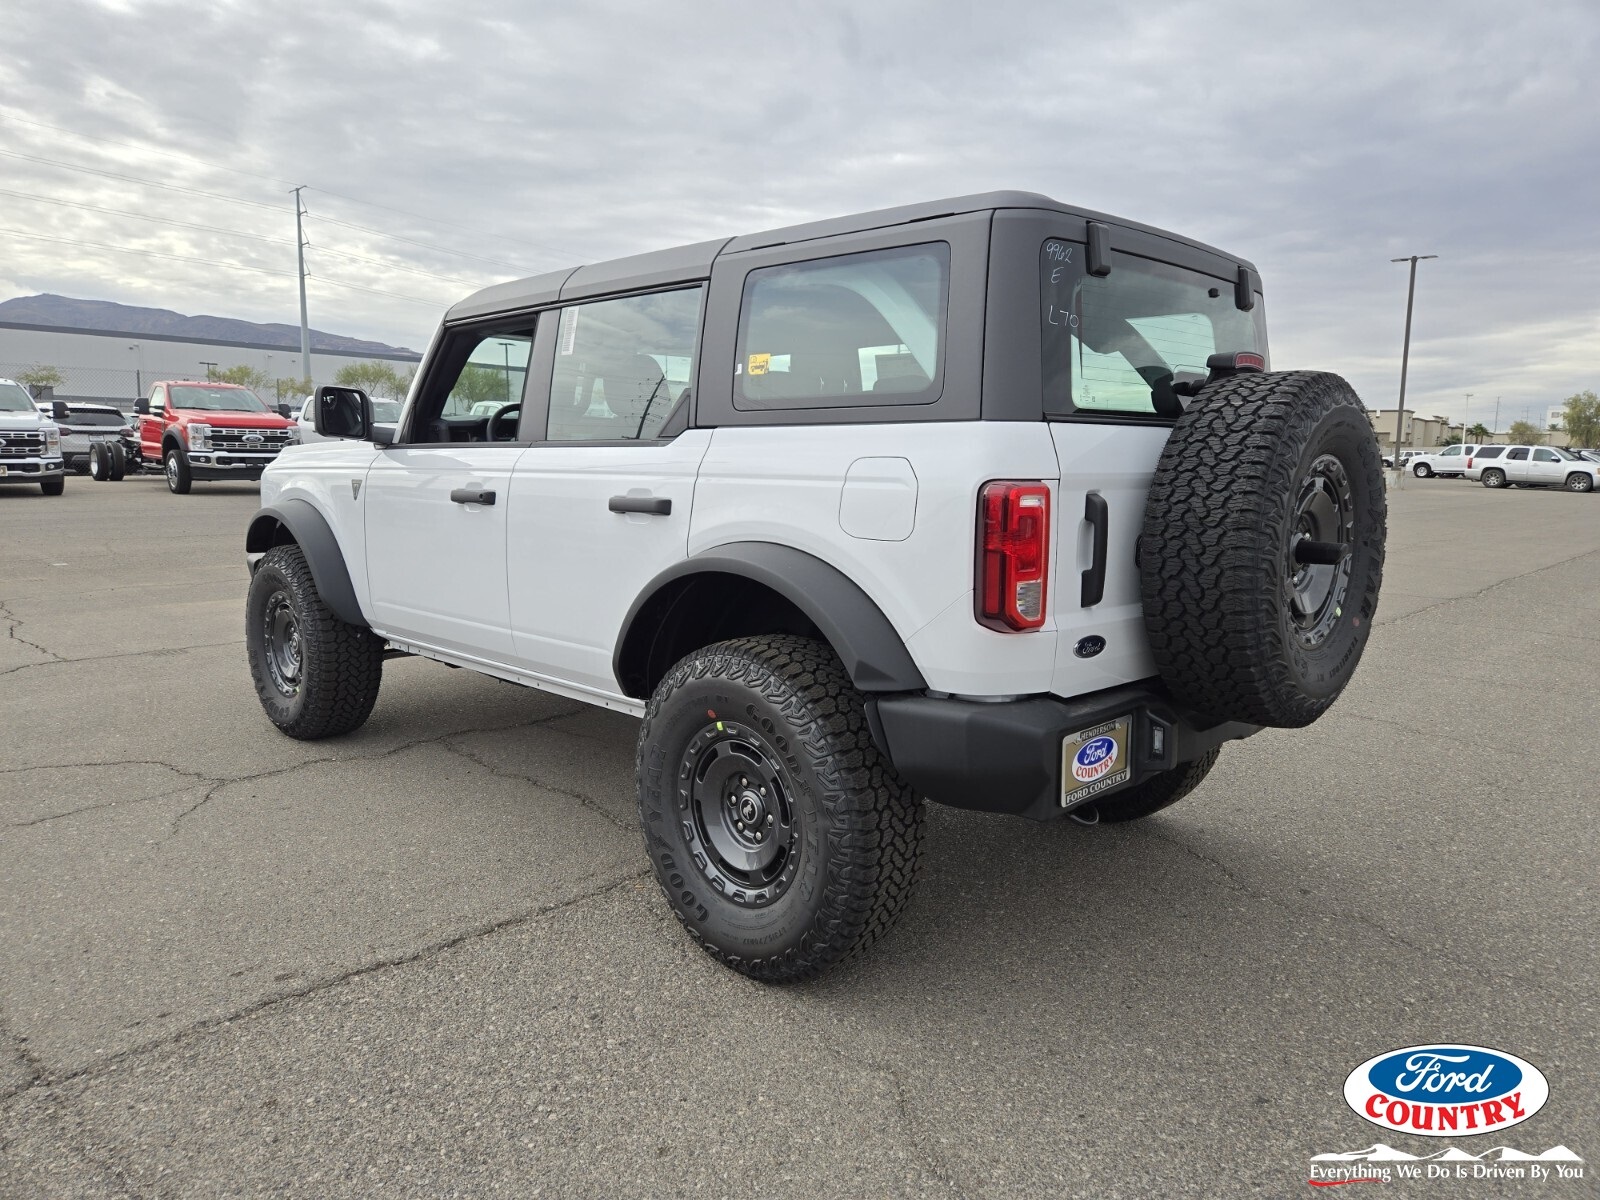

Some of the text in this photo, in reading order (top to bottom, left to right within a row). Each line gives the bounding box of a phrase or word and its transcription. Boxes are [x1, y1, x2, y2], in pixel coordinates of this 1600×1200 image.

[1046, 242, 1073, 264] 9962
[1050, 266, 1065, 284] E
[1080, 722, 1116, 740] HENDERSON
[1084, 740, 1108, 764] Ford
[1075, 753, 1114, 779] COUNTRY
[1066, 771, 1127, 804] FORD COUNTRY
